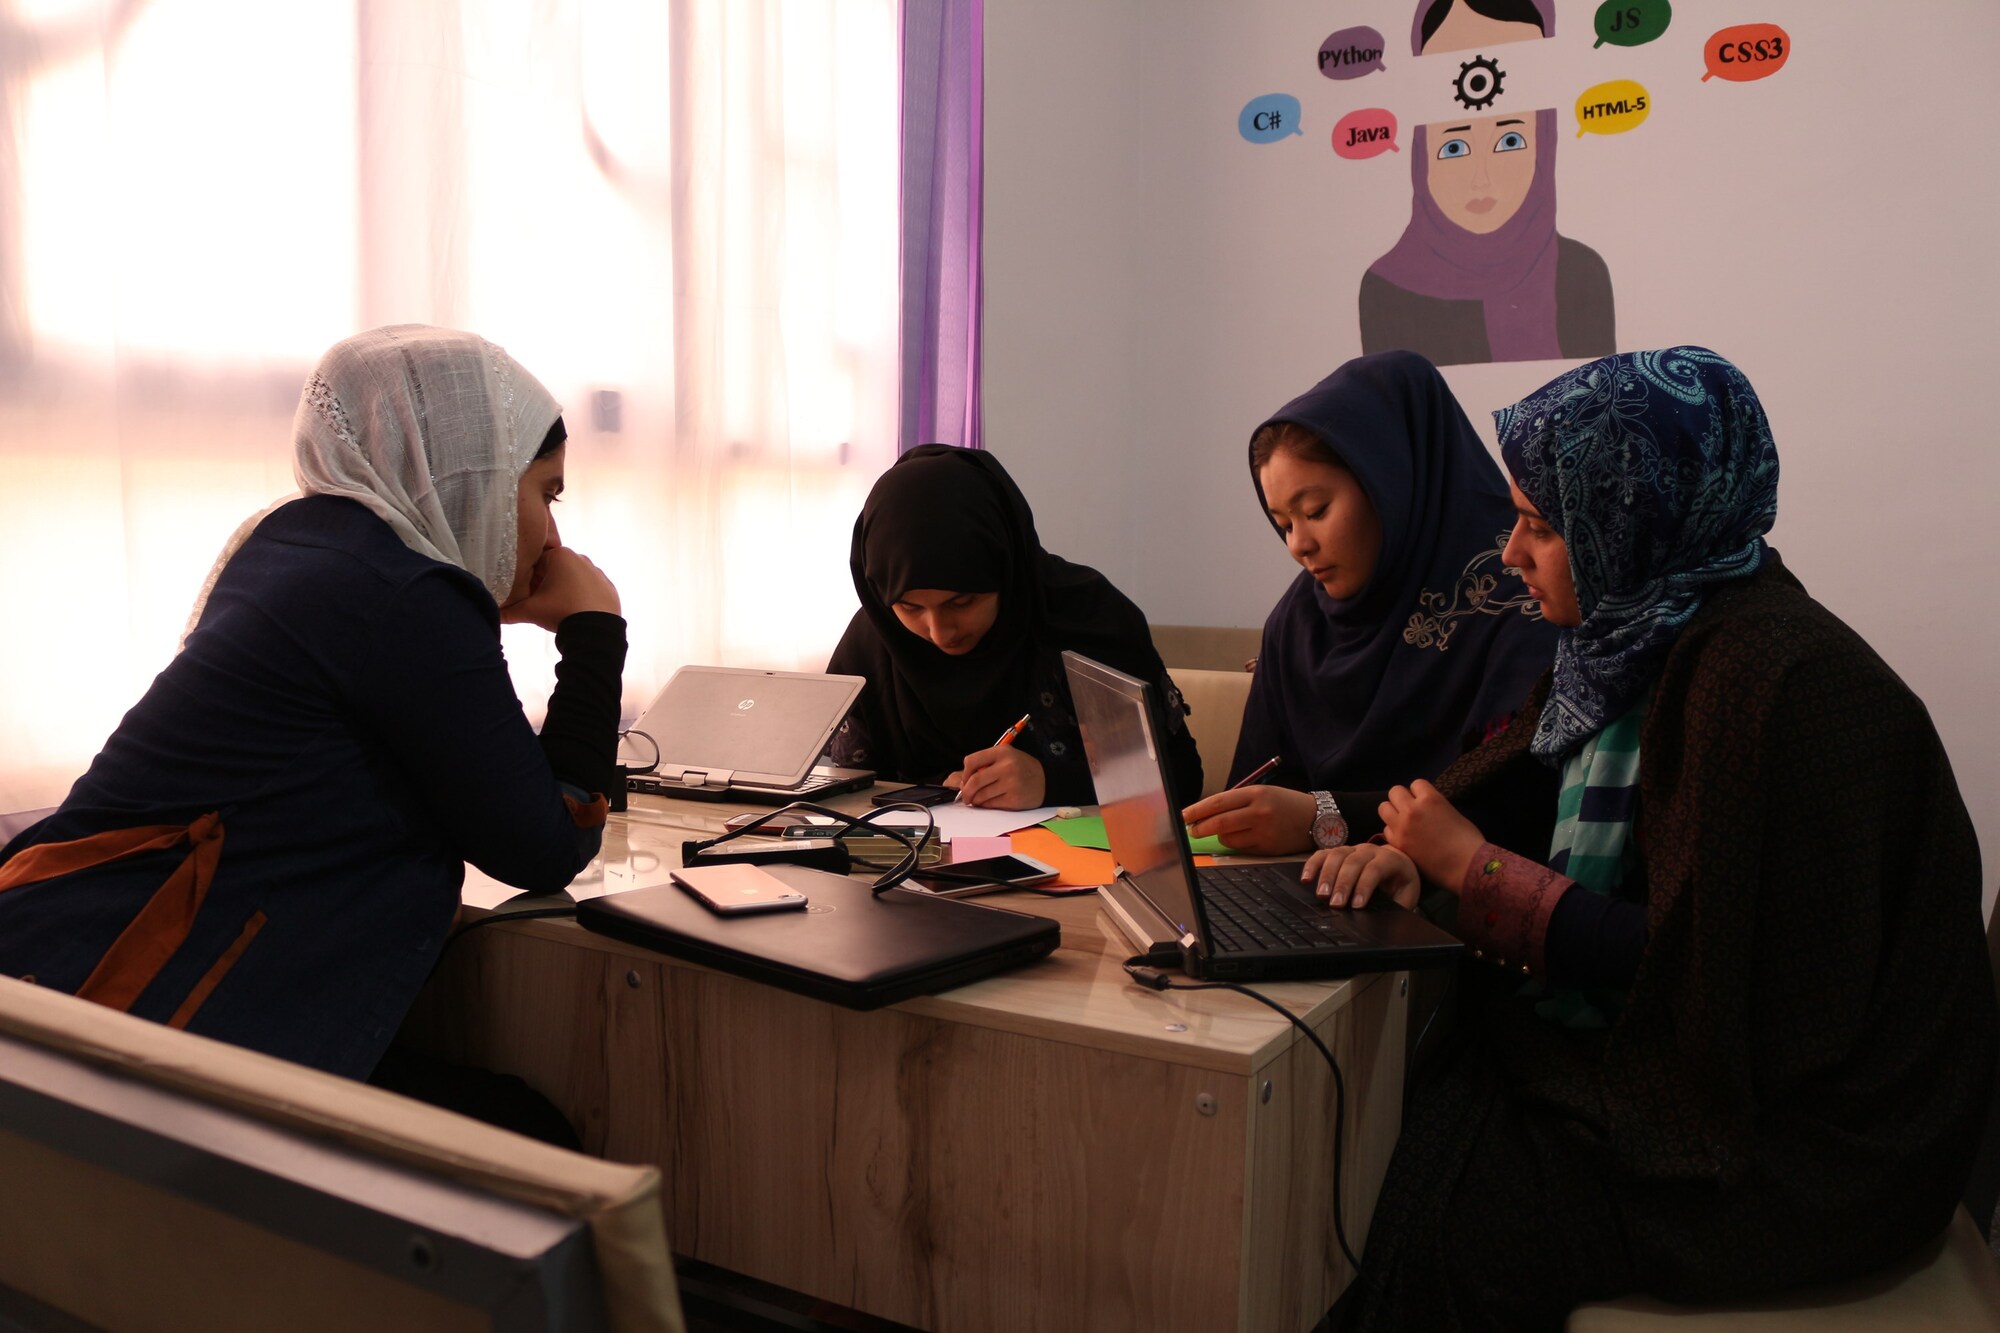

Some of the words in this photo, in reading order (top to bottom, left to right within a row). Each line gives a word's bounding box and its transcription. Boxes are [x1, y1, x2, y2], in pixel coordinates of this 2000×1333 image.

[1610, 7, 1641, 32] JS
[1718, 37, 1784, 63] CSS3
[1583, 97, 1646, 119] HTML-5
[1253, 110, 1282, 131] C#
[1346, 126, 1390, 147] Java
